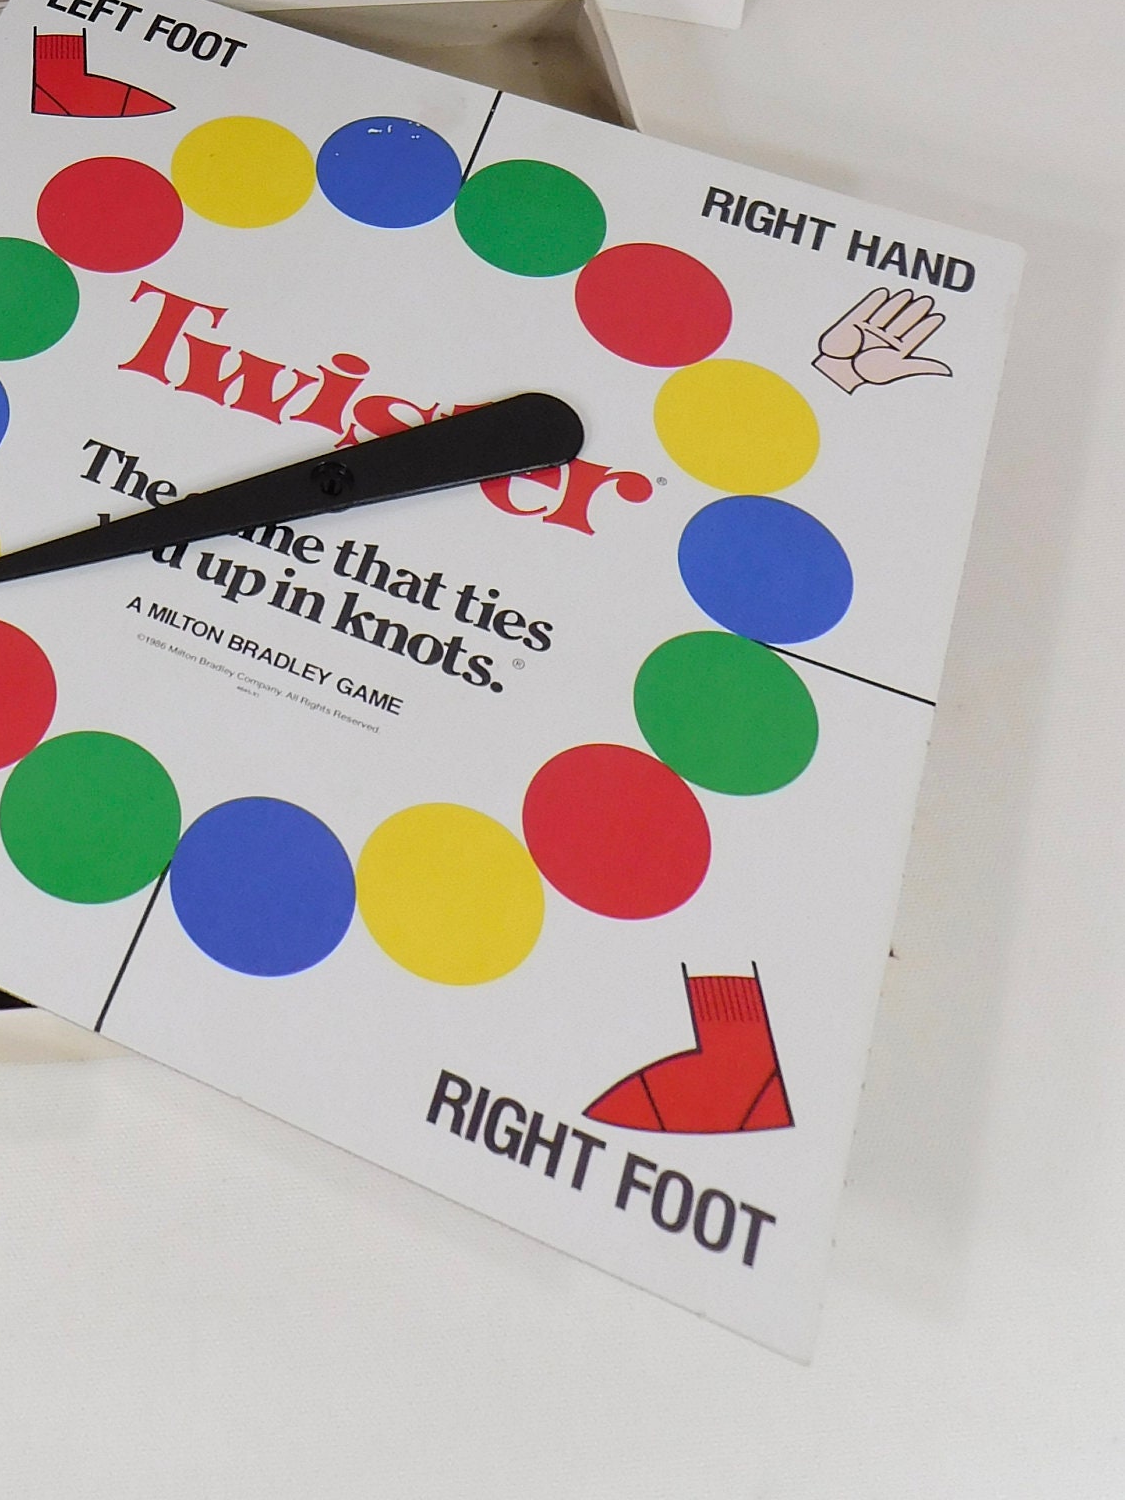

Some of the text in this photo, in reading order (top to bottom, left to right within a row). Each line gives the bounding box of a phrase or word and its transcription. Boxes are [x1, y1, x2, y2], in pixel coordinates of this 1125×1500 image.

[143, 13, 248, 68] FOOT
[701, 186, 976, 293] RIGHT HAND
[80, 438, 177, 508] The
[332, 540, 447, 611] that
[456, 587, 555, 653] ties
[196, 551, 266, 603] up
[267, 568, 325, 620] in
[125, 596, 404, 715] A MILTON BRADLEY GAME
[167, 644, 198, 662] Milton
[199, 656, 236, 678] Bradley
[300, 697, 332, 716] Rights
[426, 1069, 776, 1268] RIGHT FOOT
